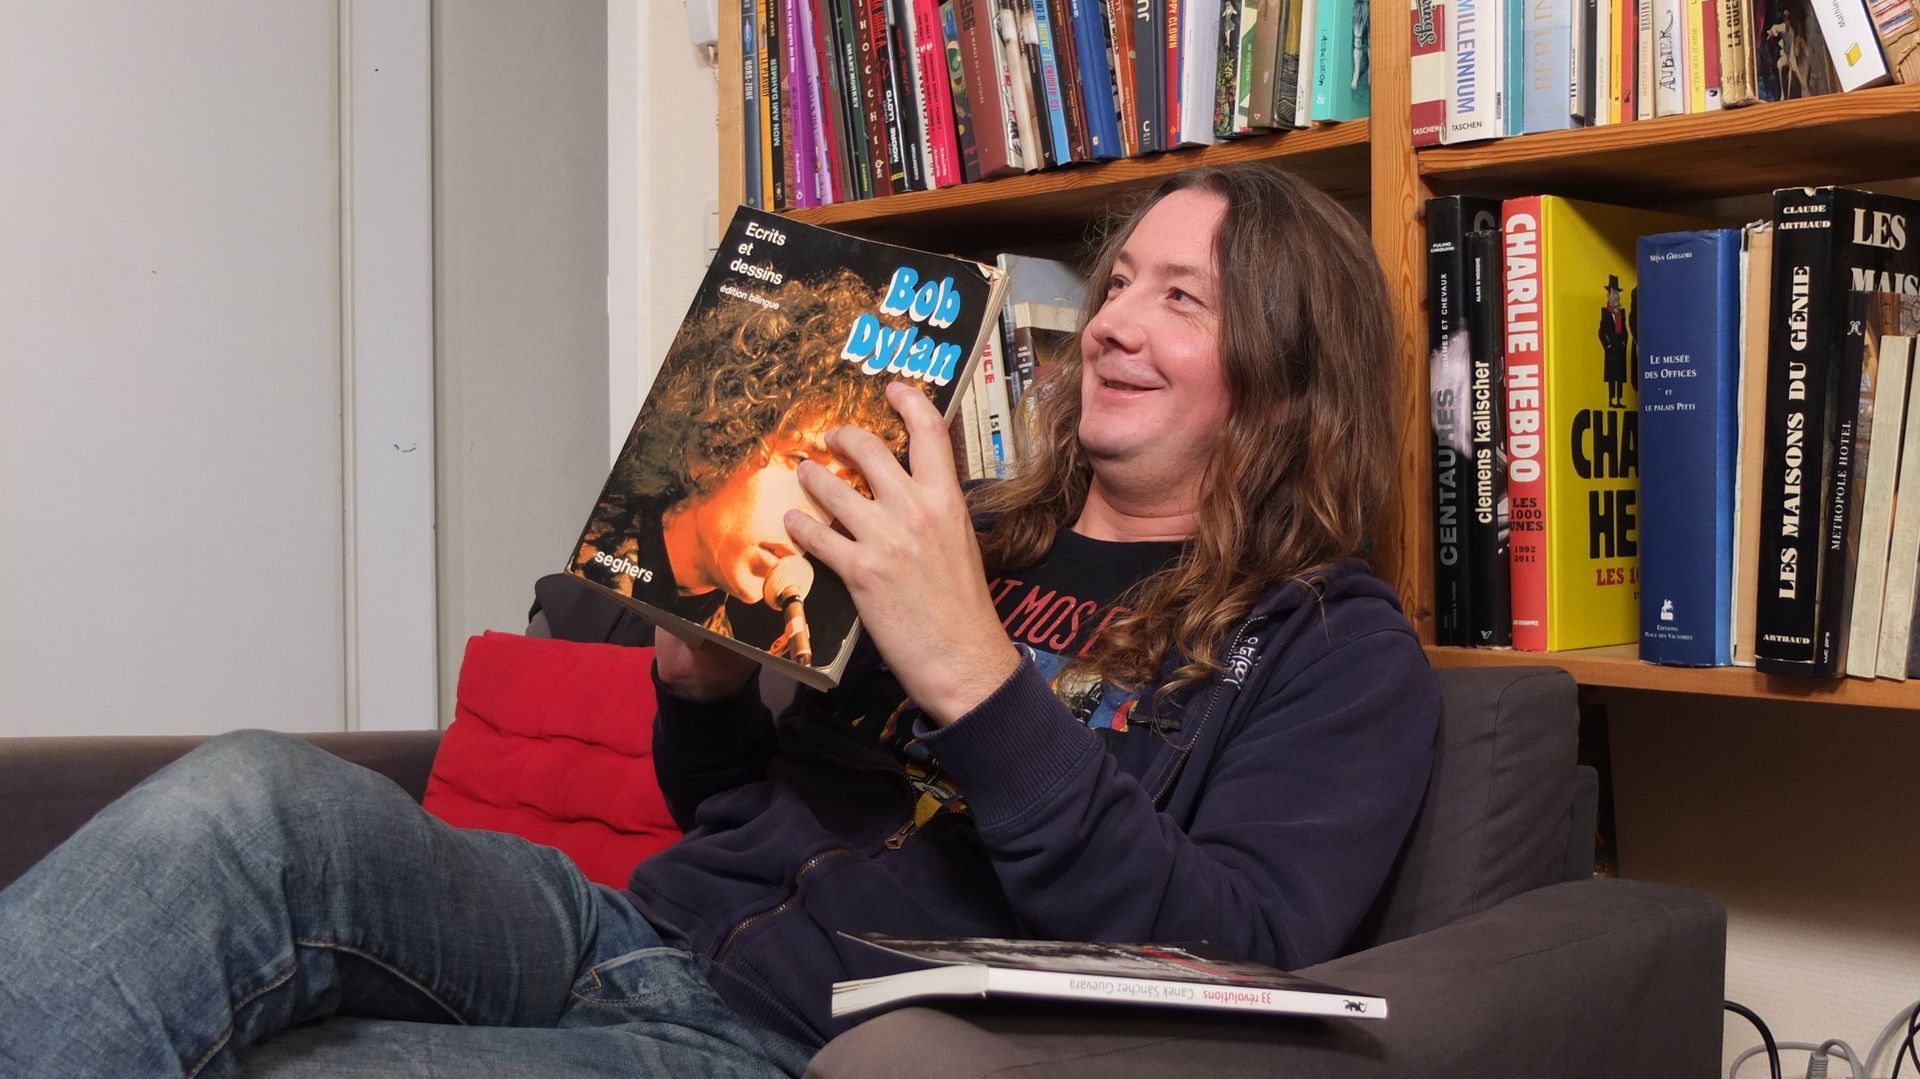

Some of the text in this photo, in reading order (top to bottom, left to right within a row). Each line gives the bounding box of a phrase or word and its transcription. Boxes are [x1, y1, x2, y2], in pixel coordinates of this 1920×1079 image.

[1640, 0, 1651, 31] DESSINS
[1168, 17, 1178, 49] CLOWN
[1533, 0, 1554, 93] BERLIN
[1690, 28, 1700, 53] JUNIOR
[1727, 29, 1742, 48] LA
[1456, 0, 1476, 115] MILLENNIUM
[846, 43, 859, 109] SMART MONKEY
[1692, 71, 1701, 92] ACTES
[770, 58, 781, 146] MON AMI DAHMER
[886, 90, 895, 122] LLOYD
[1049, 100, 1059, 112] LES
[1412, 126, 1441, 136] TASCHEN
[1451, 120, 1483, 131] TASCHEN
[890, 127, 900, 163] MOORE
[910, 143, 920, 180] casterman
[1783, 204, 1826, 215] CLAUDE
[745, 222, 787, 247] Ecrits
[1778, 220, 1831, 231] ARTHAUD
[1851, 206, 1906, 251] LES
[738, 242, 754, 257] et
[730, 258, 783, 287] dessins
[719, 285, 780, 312] édition bilingue
[880, 266, 961, 329] Bob
[1474, 286, 1482, 303] ALAIN
[840, 313, 962, 387] Dylan
[1506, 213, 1541, 483] CHARLIE HEBDO
[1472, 360, 1492, 443] kalischer
[1436, 272, 1458, 566] CENTAURES HOMMES ET CHEVAUX
[1777, 265, 1811, 600] LES MAISONS DU GÉNIE
[1473, 448, 1493, 524] clemens
[1831, 420, 1852, 550] METROPOLE HOTEL
[1511, 510, 1541, 520] 1000
[1512, 498, 1537, 508] LES
[1510, 521, 1544, 532] UNES
[1514, 546, 1536, 555] 1992
[1514, 555, 1536, 564] 2011
[594, 550, 654, 583] seghers
[1596, 566, 1625, 587] LES
[1763, 633, 1811, 645] ARTHAUD
[1068, 977, 1273, 1006] 33 révolutions Canek Sánchez Guevara
